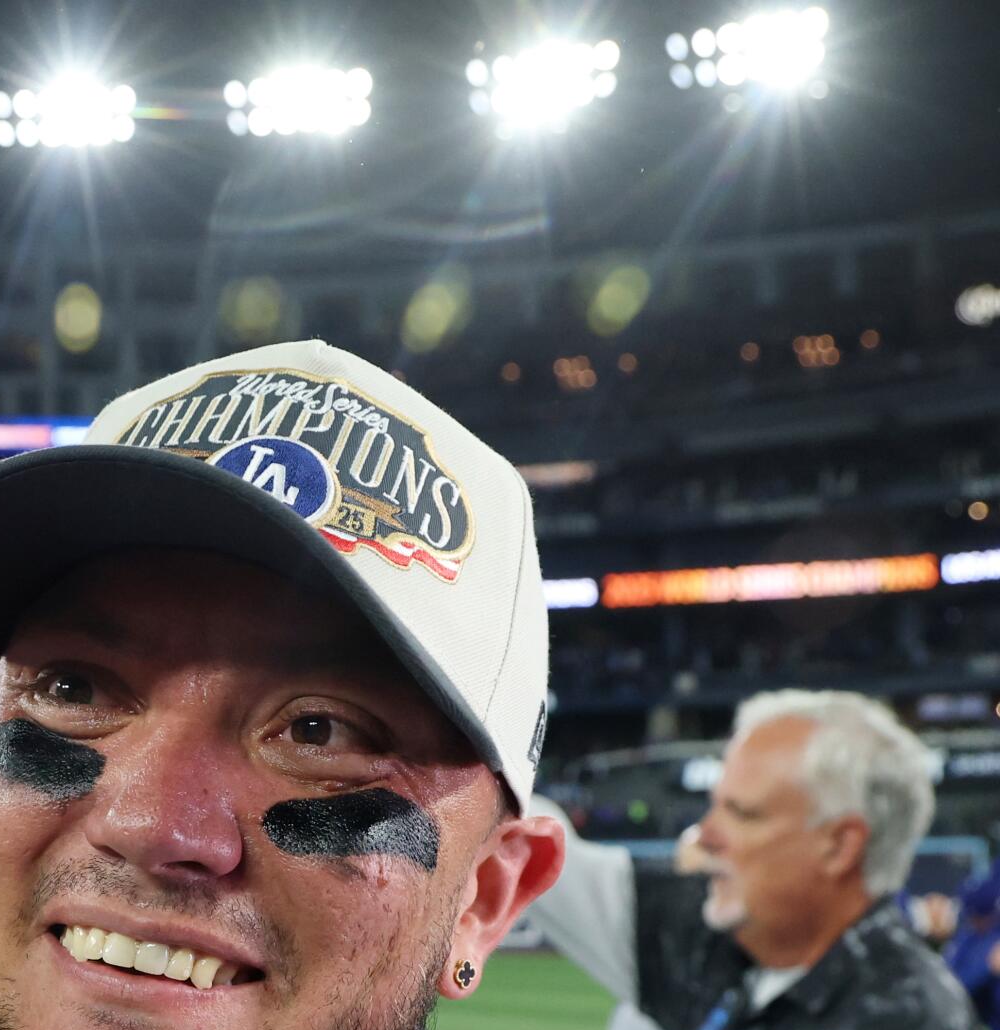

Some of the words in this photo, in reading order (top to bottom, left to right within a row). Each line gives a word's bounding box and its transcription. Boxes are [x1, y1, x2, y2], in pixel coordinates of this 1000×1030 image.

[229, 373, 324, 406] World
[305, 383, 390, 434] Series
[124, 392, 460, 549] CHAMPIONS
[241, 444, 300, 506] LA
